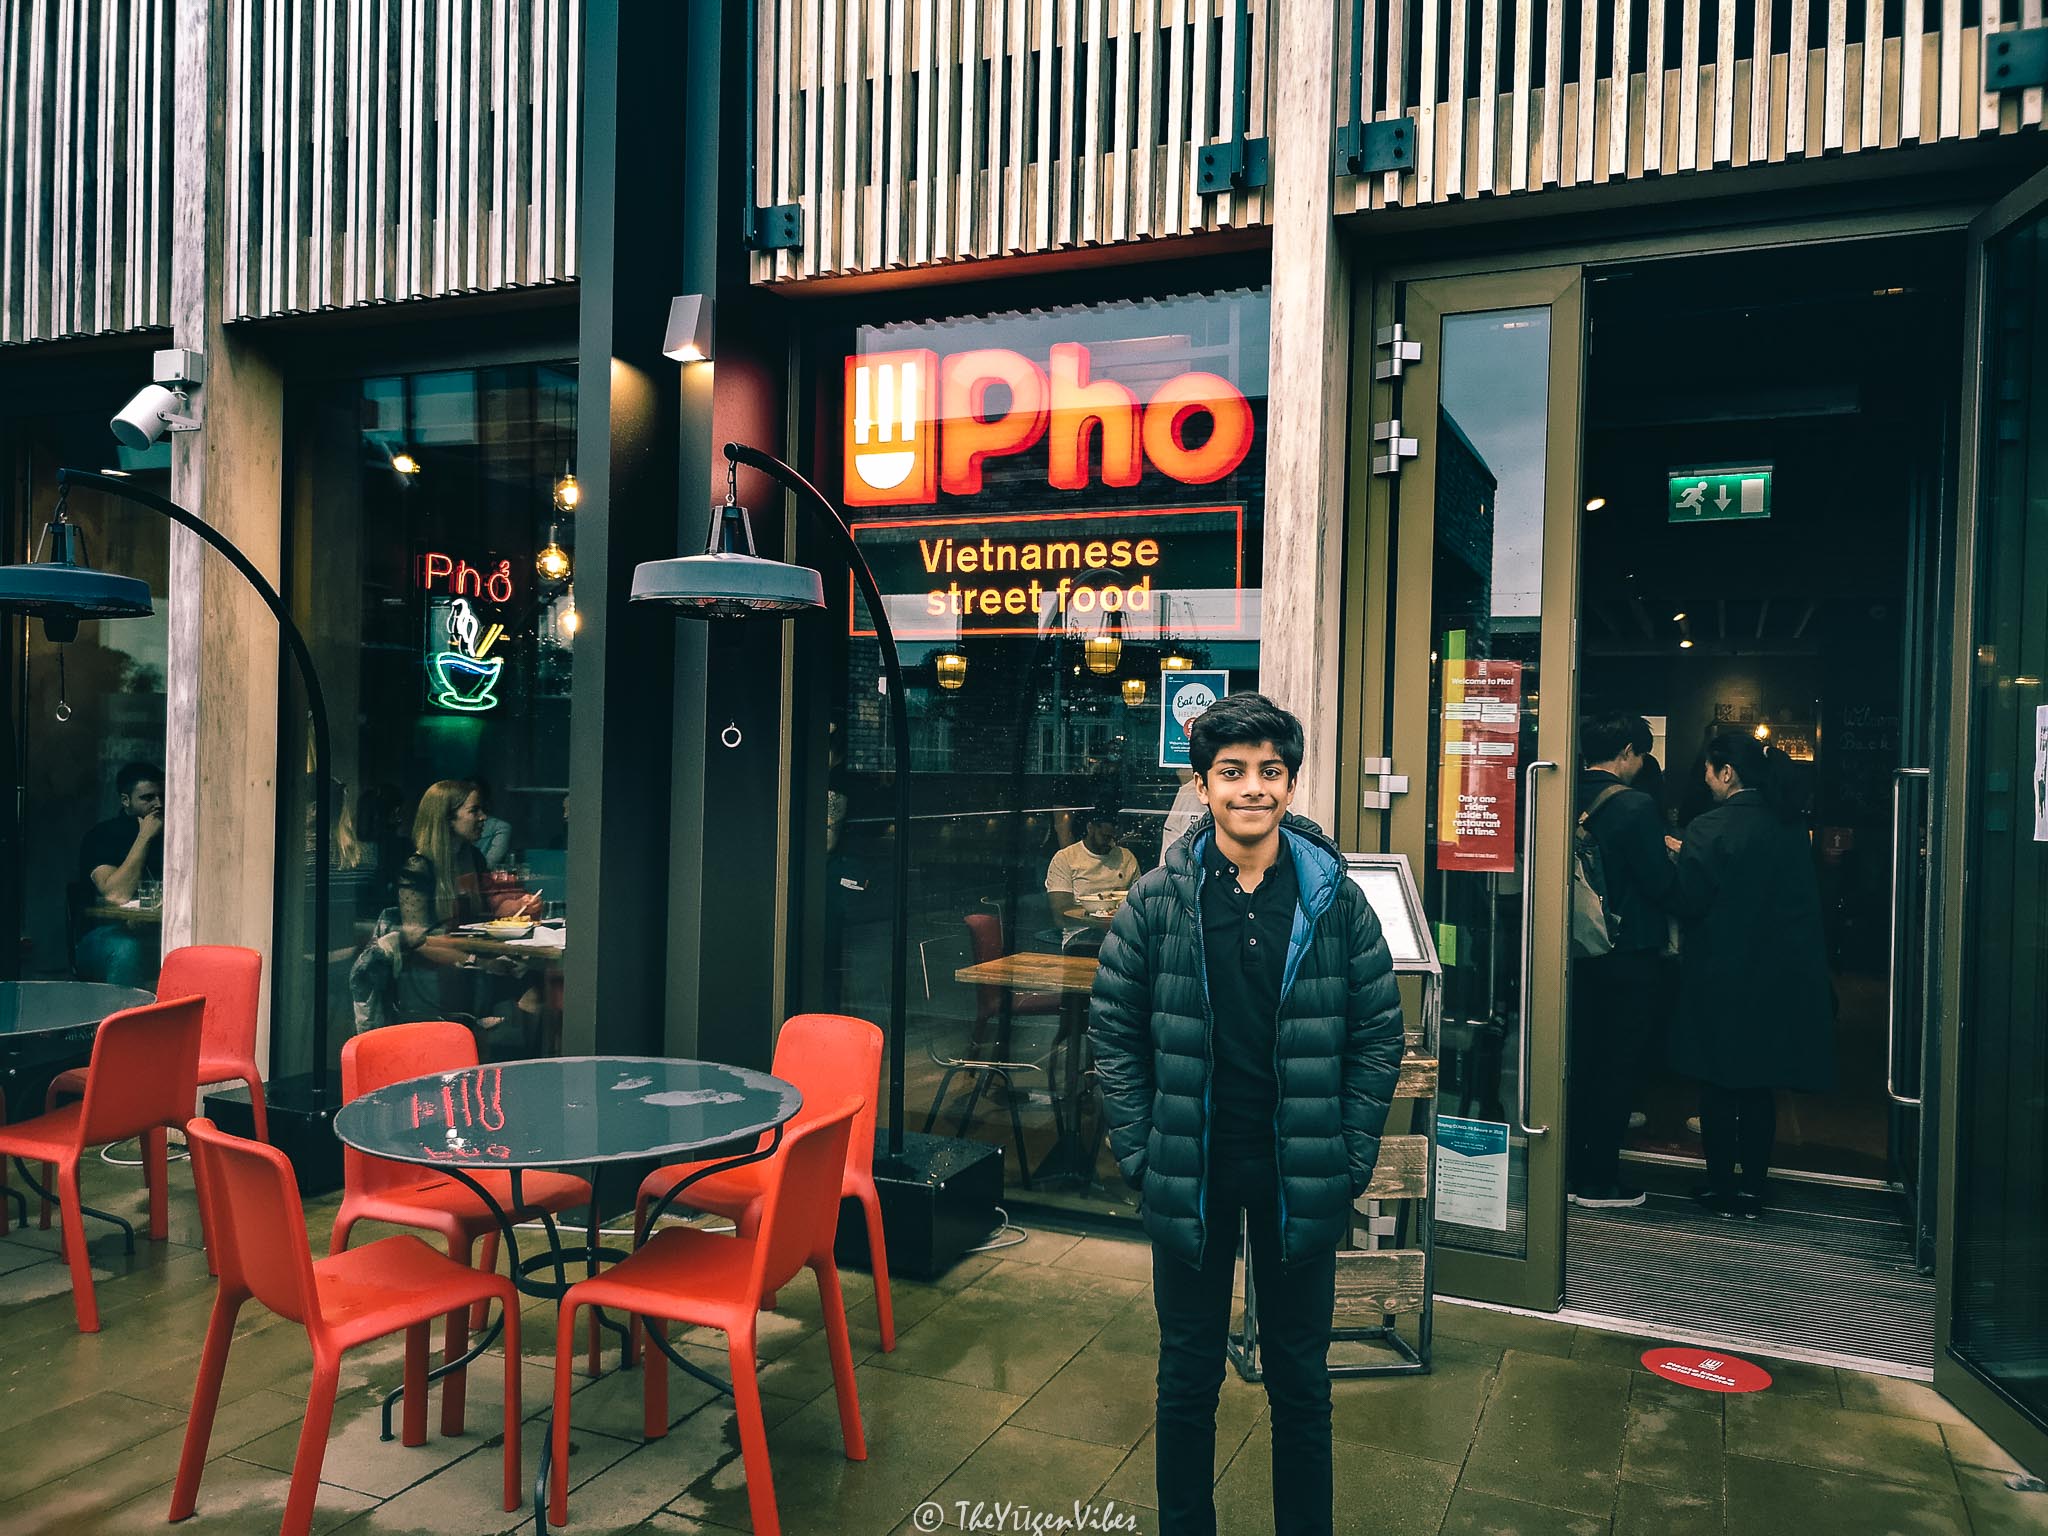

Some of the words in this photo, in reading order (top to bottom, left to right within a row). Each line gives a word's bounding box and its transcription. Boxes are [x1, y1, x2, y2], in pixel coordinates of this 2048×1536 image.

[941, 342, 1253, 495] Pho
[919, 537, 1159, 574] Vietnamese
[926, 580, 1041, 615] street
[1059, 575, 1151, 612] food
[1177, 695, 1194, 708] Eat
[1196, 693, 1213, 707] Out
[1458, 795, 1478, 803] Only
[1465, 803, 1489, 811] rider
[1455, 810, 1482, 818] inside
[1483, 811, 1498, 819] the
[1452, 819, 1501, 828] restaurant
[1455, 827, 1466, 835] at
[1474, 827, 1498, 836] time.
